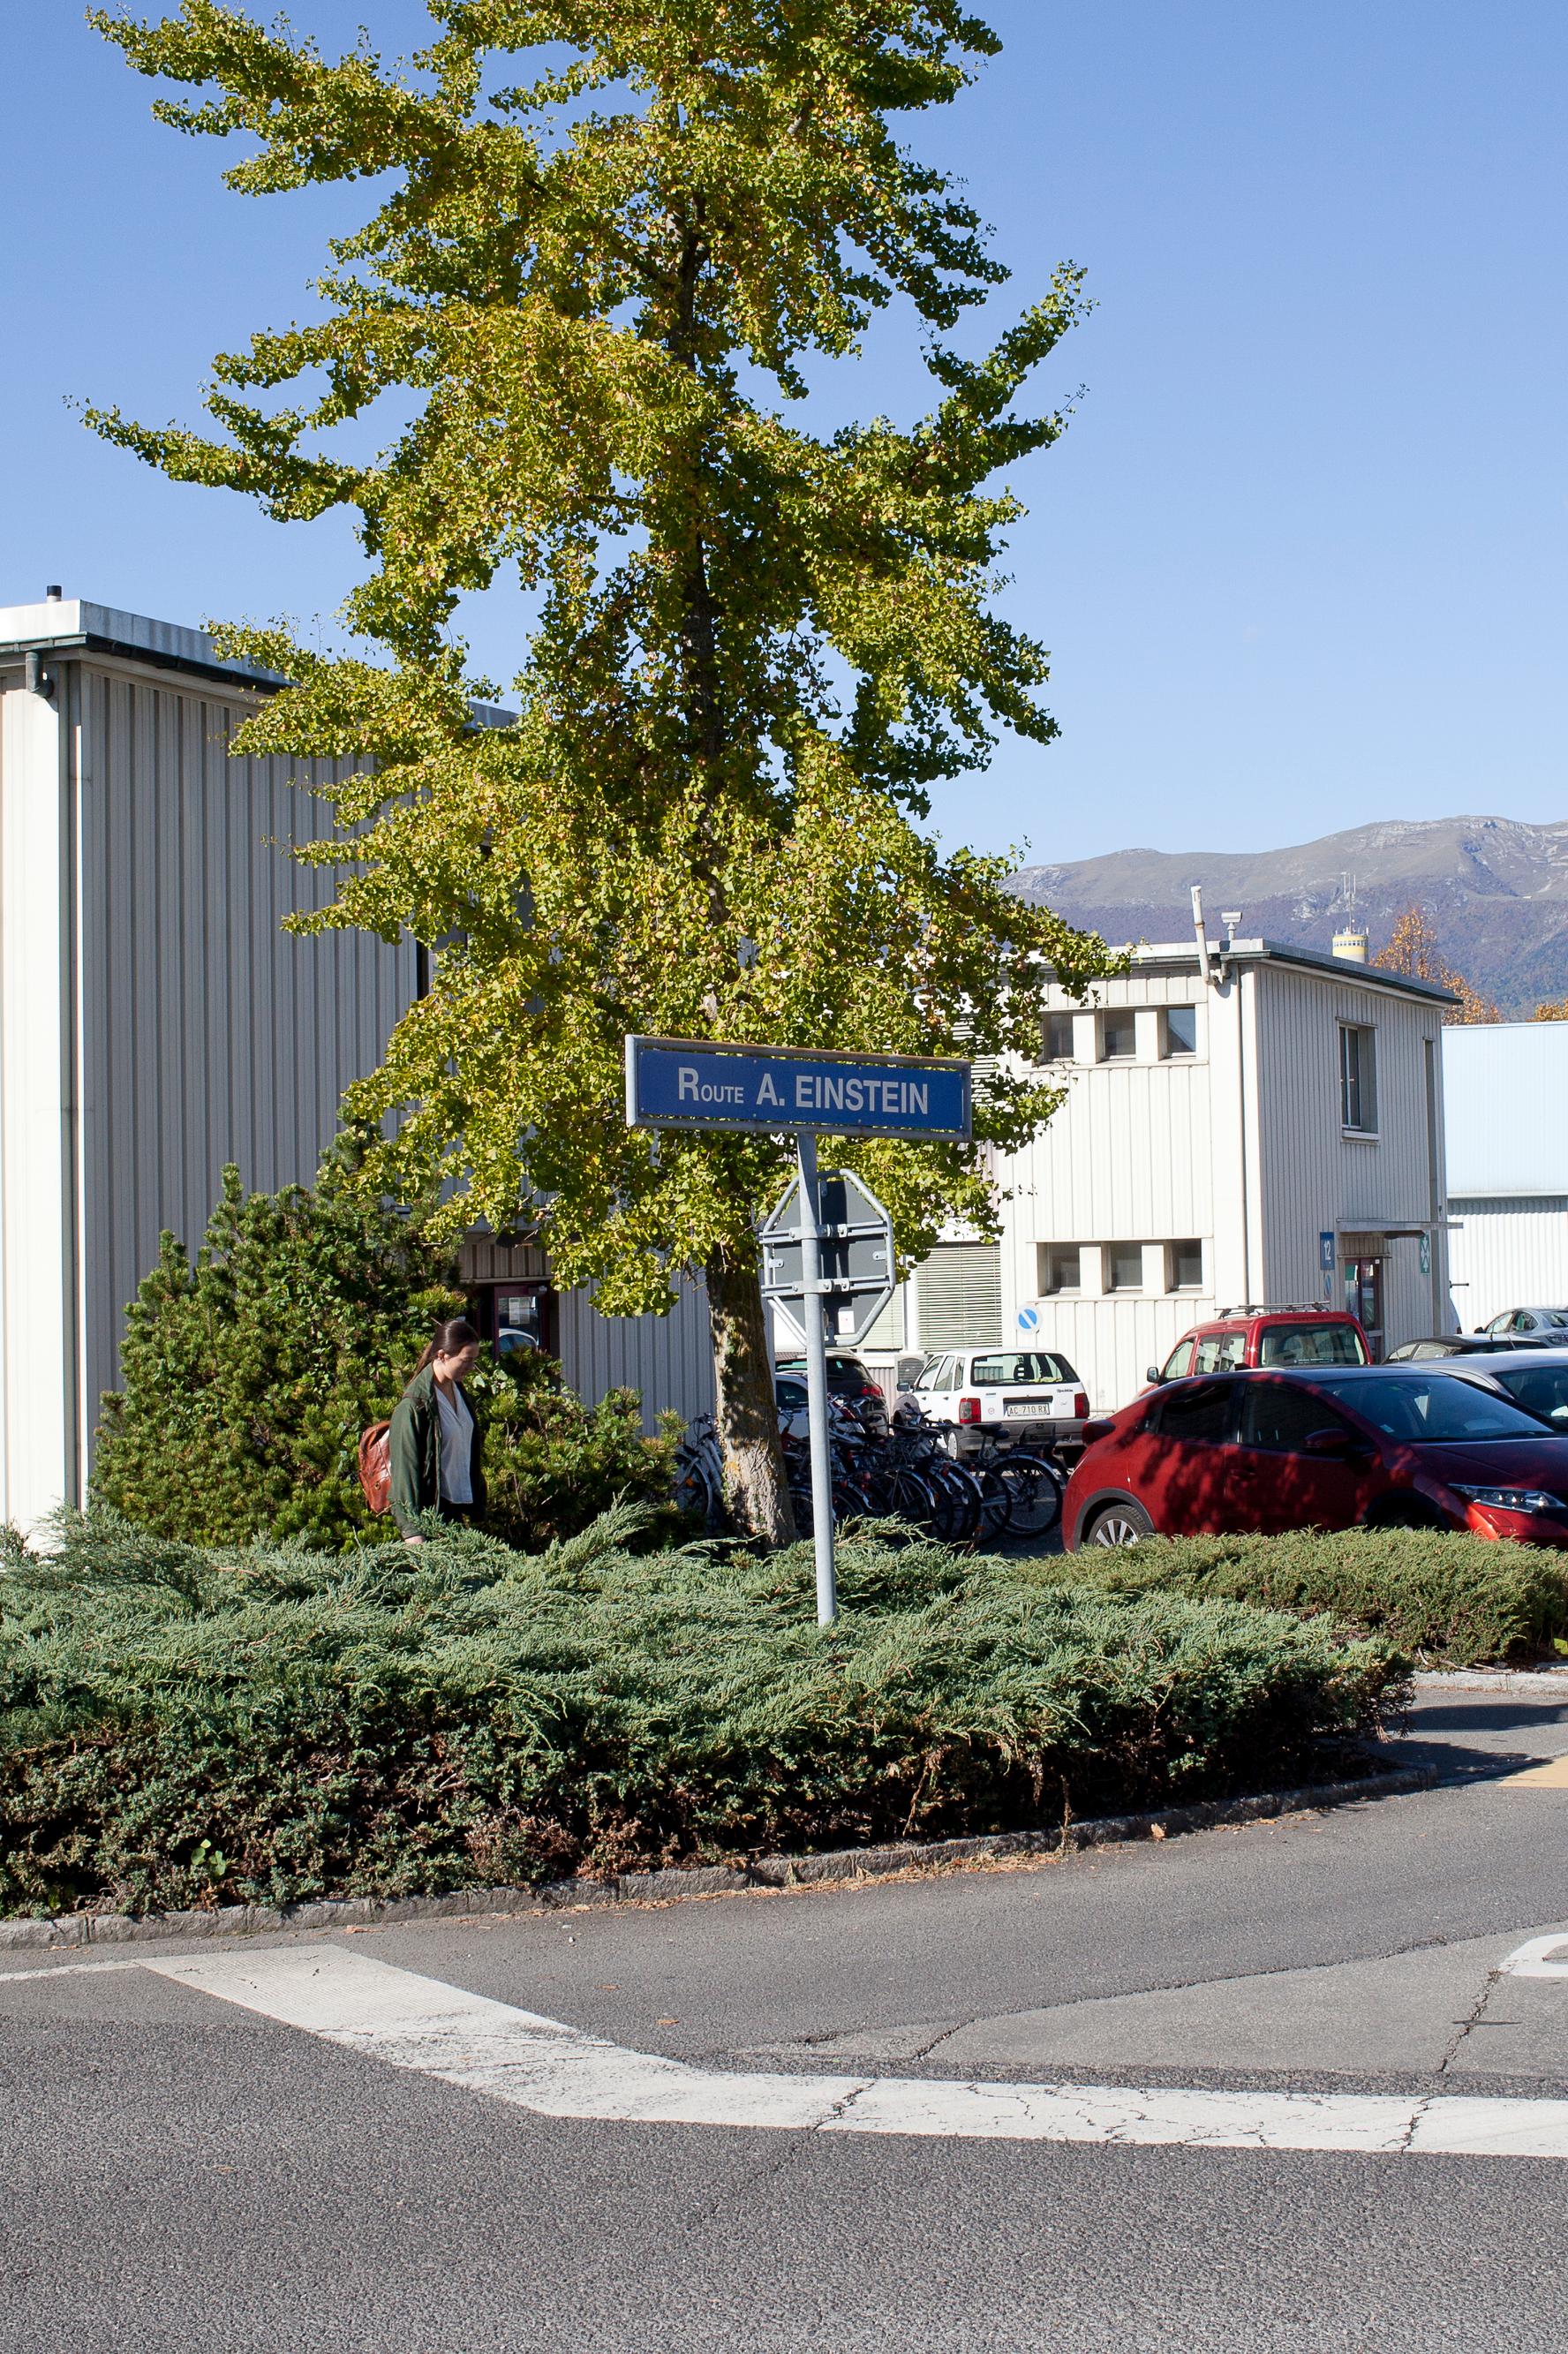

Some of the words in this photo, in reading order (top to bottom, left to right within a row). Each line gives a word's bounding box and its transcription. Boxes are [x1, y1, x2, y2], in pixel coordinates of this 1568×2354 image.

[756, 1073, 785, 1106] A.
[795, 1075, 928, 1114] EINSTEIN
[1324, 1241, 1331, 1261] 12
